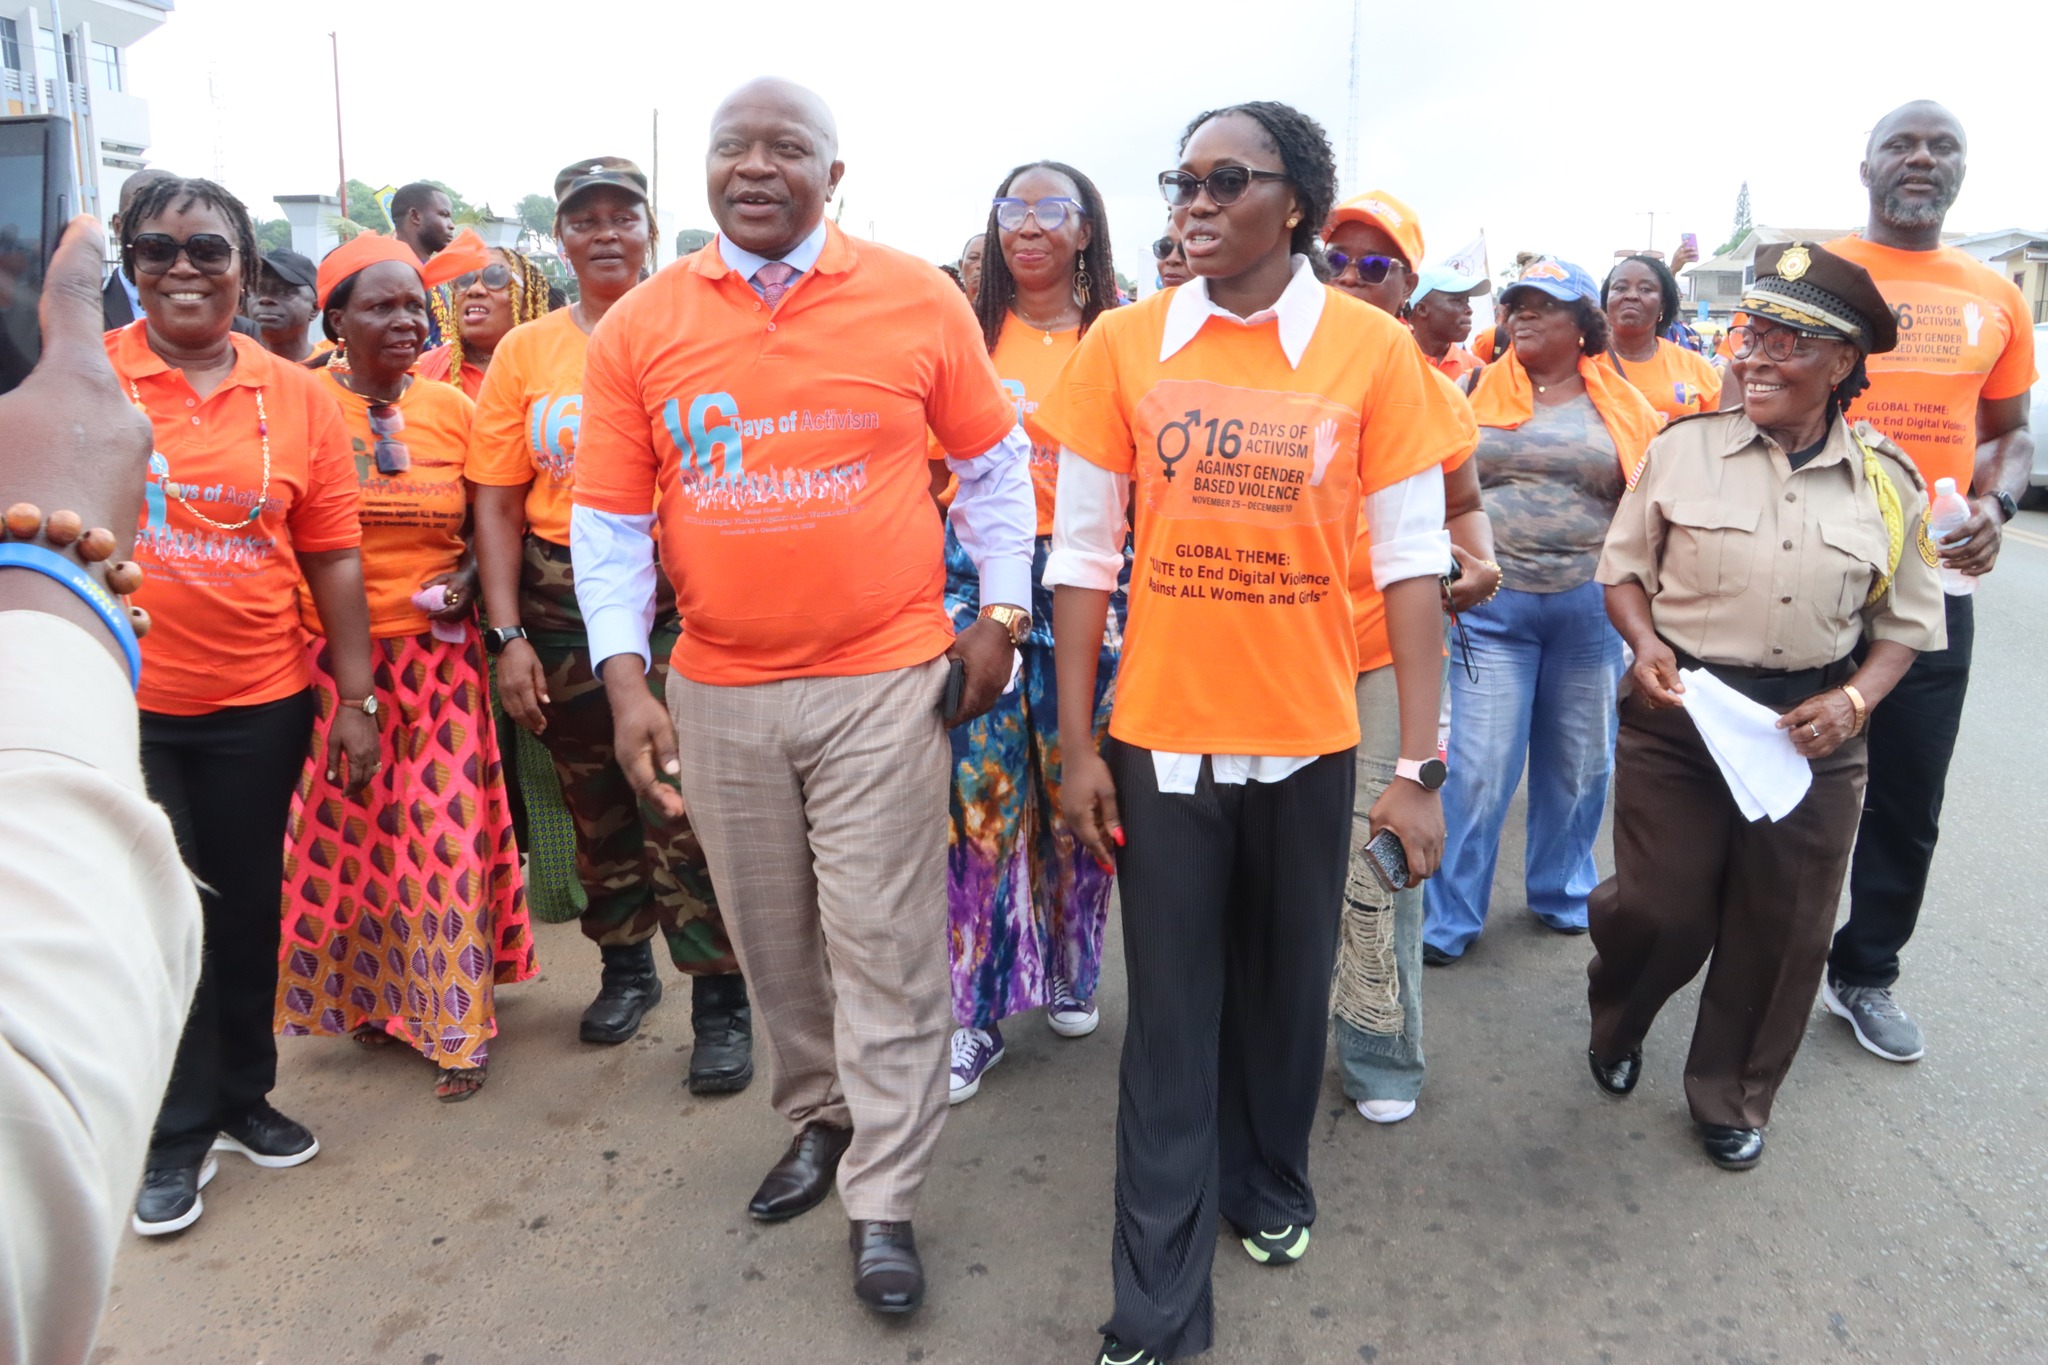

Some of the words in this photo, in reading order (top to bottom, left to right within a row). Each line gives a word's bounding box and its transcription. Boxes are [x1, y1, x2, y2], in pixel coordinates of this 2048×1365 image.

[1916, 304, 1943, 315] DAYS
[1945, 306, 1958, 316] OF
[1916, 316, 1962, 327] ACTIVISM
[1925, 333, 1962, 343] GENDER
[1915, 344, 1961, 356] VIOLENCE
[1867, 402, 1909, 412] GLOBAL
[1913, 403, 1949, 415] THEME:
[531, 394, 583, 466] 16
[1869, 416, 1880, 426] to
[1884, 417, 1903, 427] End
[1906, 417, 1939, 429] Digital
[662, 391, 743, 485] 16
[730, 416, 774, 440] Days
[779, 410, 797, 432] of
[801, 408, 879, 431] Activism
[1204, 418, 1244, 459] 16
[1249, 422, 1285, 438] DAYS
[1289, 424, 1308, 440] OF
[1893, 431, 1931, 442] Women
[1934, 434, 1950, 443] and
[1245, 439, 1308, 459] ACTIVISM
[1196, 459, 1251, 478] AGAINST
[1253, 465, 1305, 485] GENDER
[203, 483, 223, 502] of
[1193, 477, 1235, 494] BASED
[1238, 481, 1301, 501] VIOLENCE
[1192, 495, 1230, 508] NOVEMBER
[1231, 499, 1240, 509] 25
[1247, 501, 1285, 513] DECEMBER
[1285, 504, 1293, 513] 10
[1175, 544, 1232, 561] GLOBAL
[1236, 549, 1290, 566] THEME:
[1179, 565, 1193, 578] to
[1198, 565, 1224, 580] End
[1229, 568, 1275, 586] Digital
[1280, 571, 1330, 586] Violence
[1180, 585, 1206, 599] ALL
[1210, 587, 1265, 604] Women
[1269, 592, 1295, 605] and
